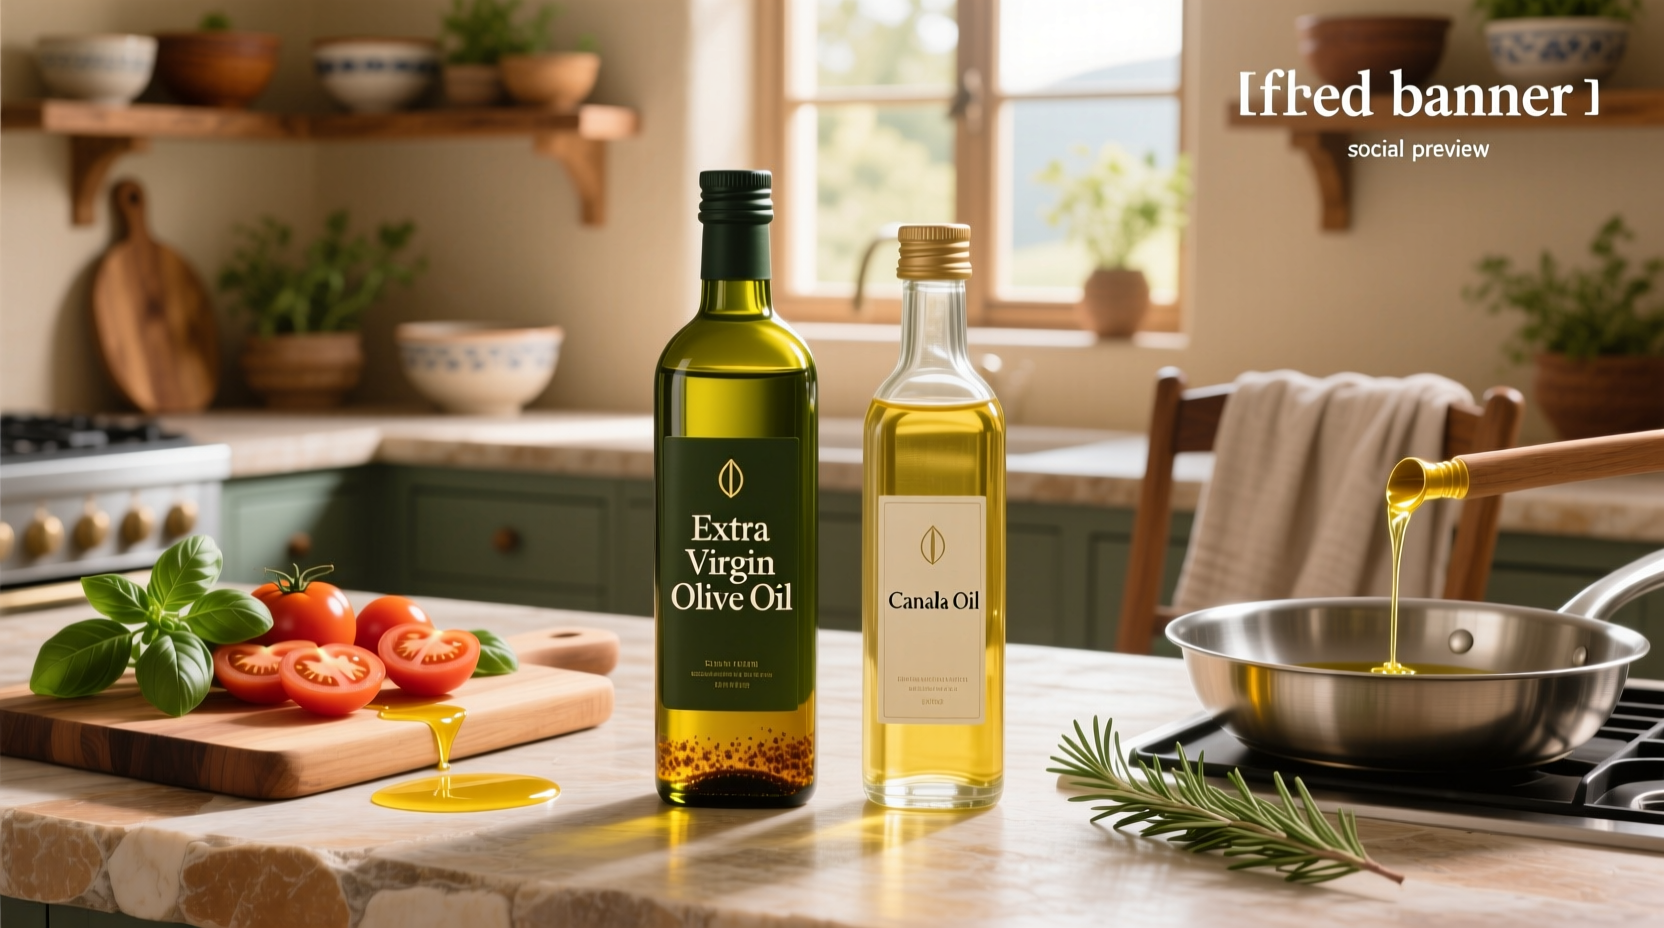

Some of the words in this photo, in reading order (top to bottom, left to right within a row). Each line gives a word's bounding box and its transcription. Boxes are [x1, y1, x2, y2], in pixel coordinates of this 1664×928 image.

[690, 514, 771, 542] Extra
[684, 548, 776, 585] Virgin
[671, 582, 744, 611] Olive
[750, 582, 793, 611] Oil
[952, 590, 979, 610] Oil
